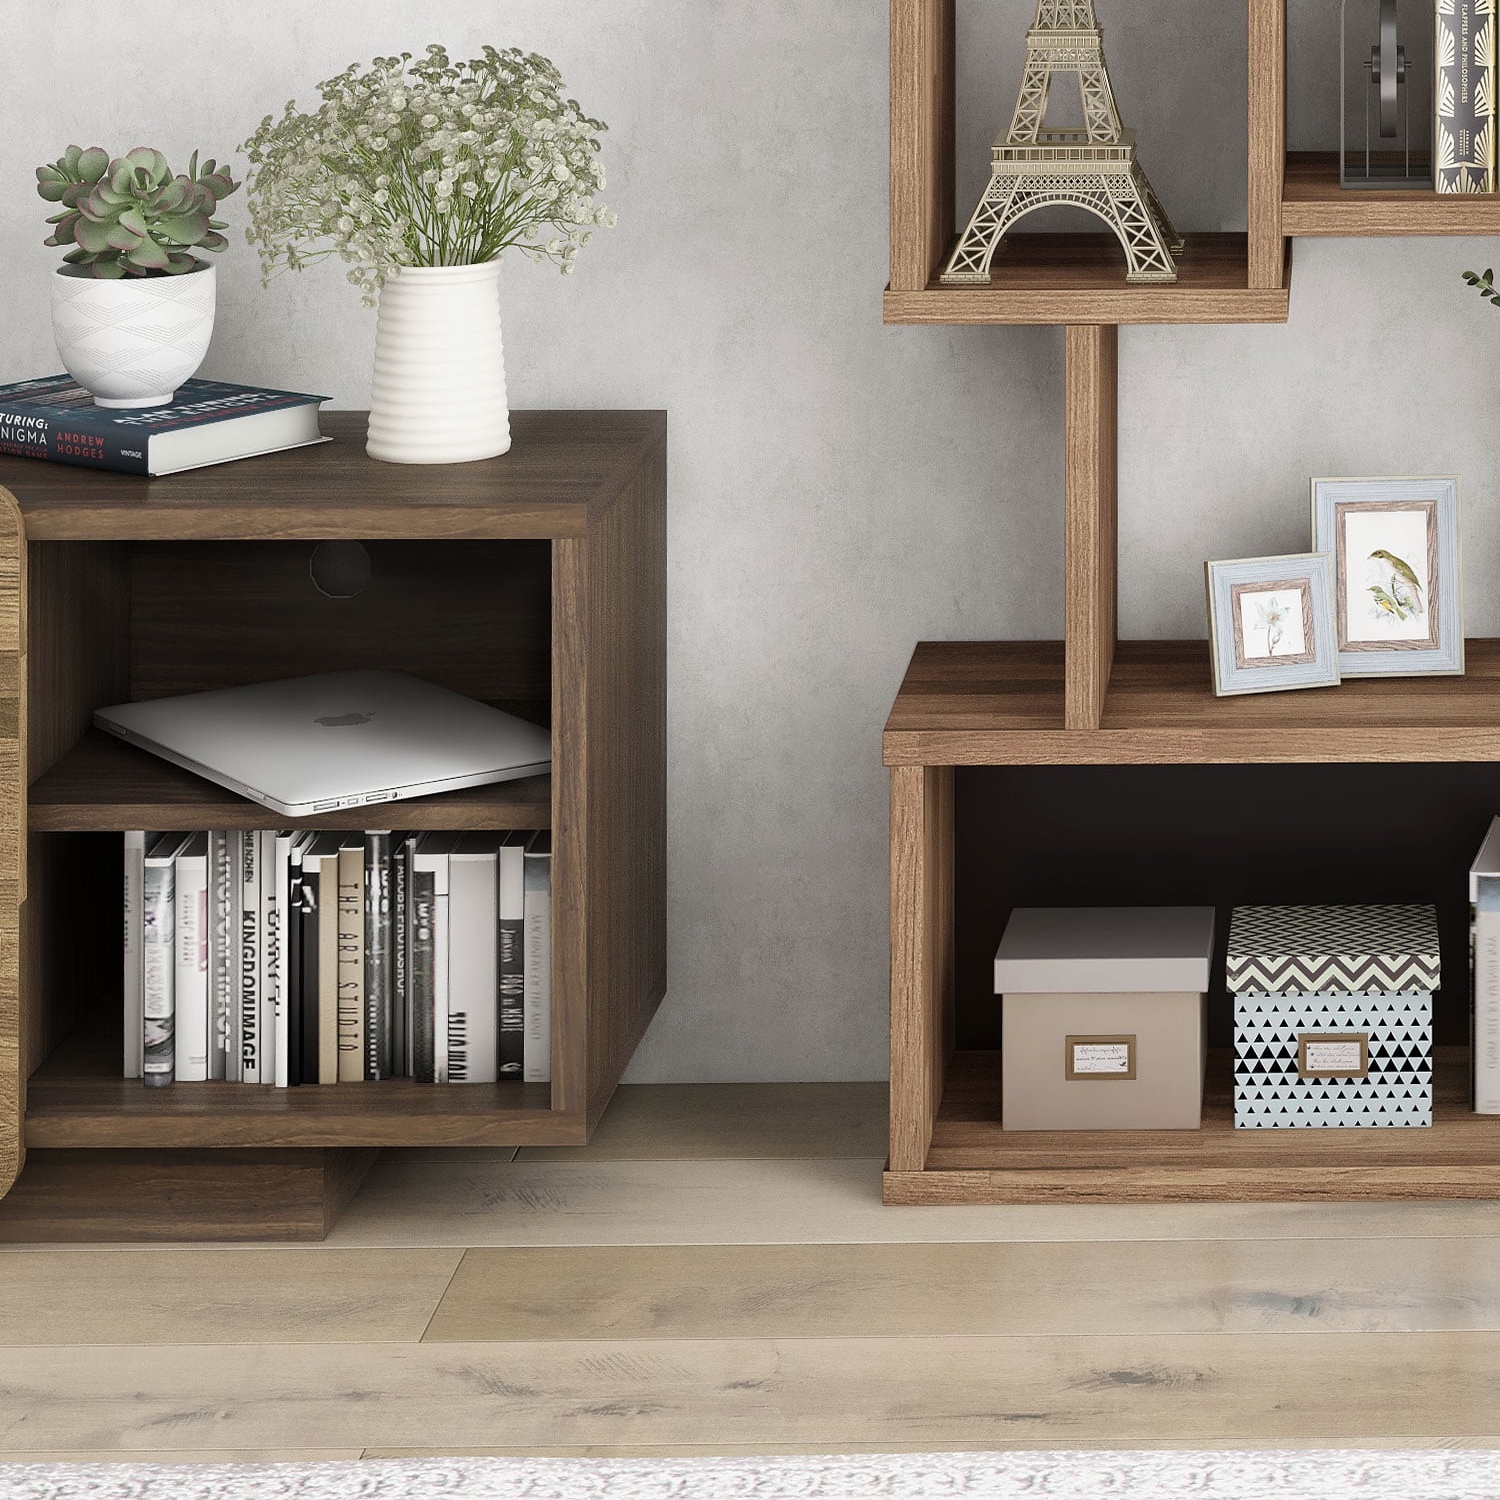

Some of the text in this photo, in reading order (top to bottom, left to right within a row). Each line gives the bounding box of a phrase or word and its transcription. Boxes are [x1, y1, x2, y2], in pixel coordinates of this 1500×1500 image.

[56, 432, 105, 446] ANDREW
[57, 443, 105, 459] HODGES
[120, 449, 142, 459] VINTAGE
[339, 883, 359, 1052] THE ART STUDIO
[243, 910, 256, 1070] KINGDOMIMAGE
